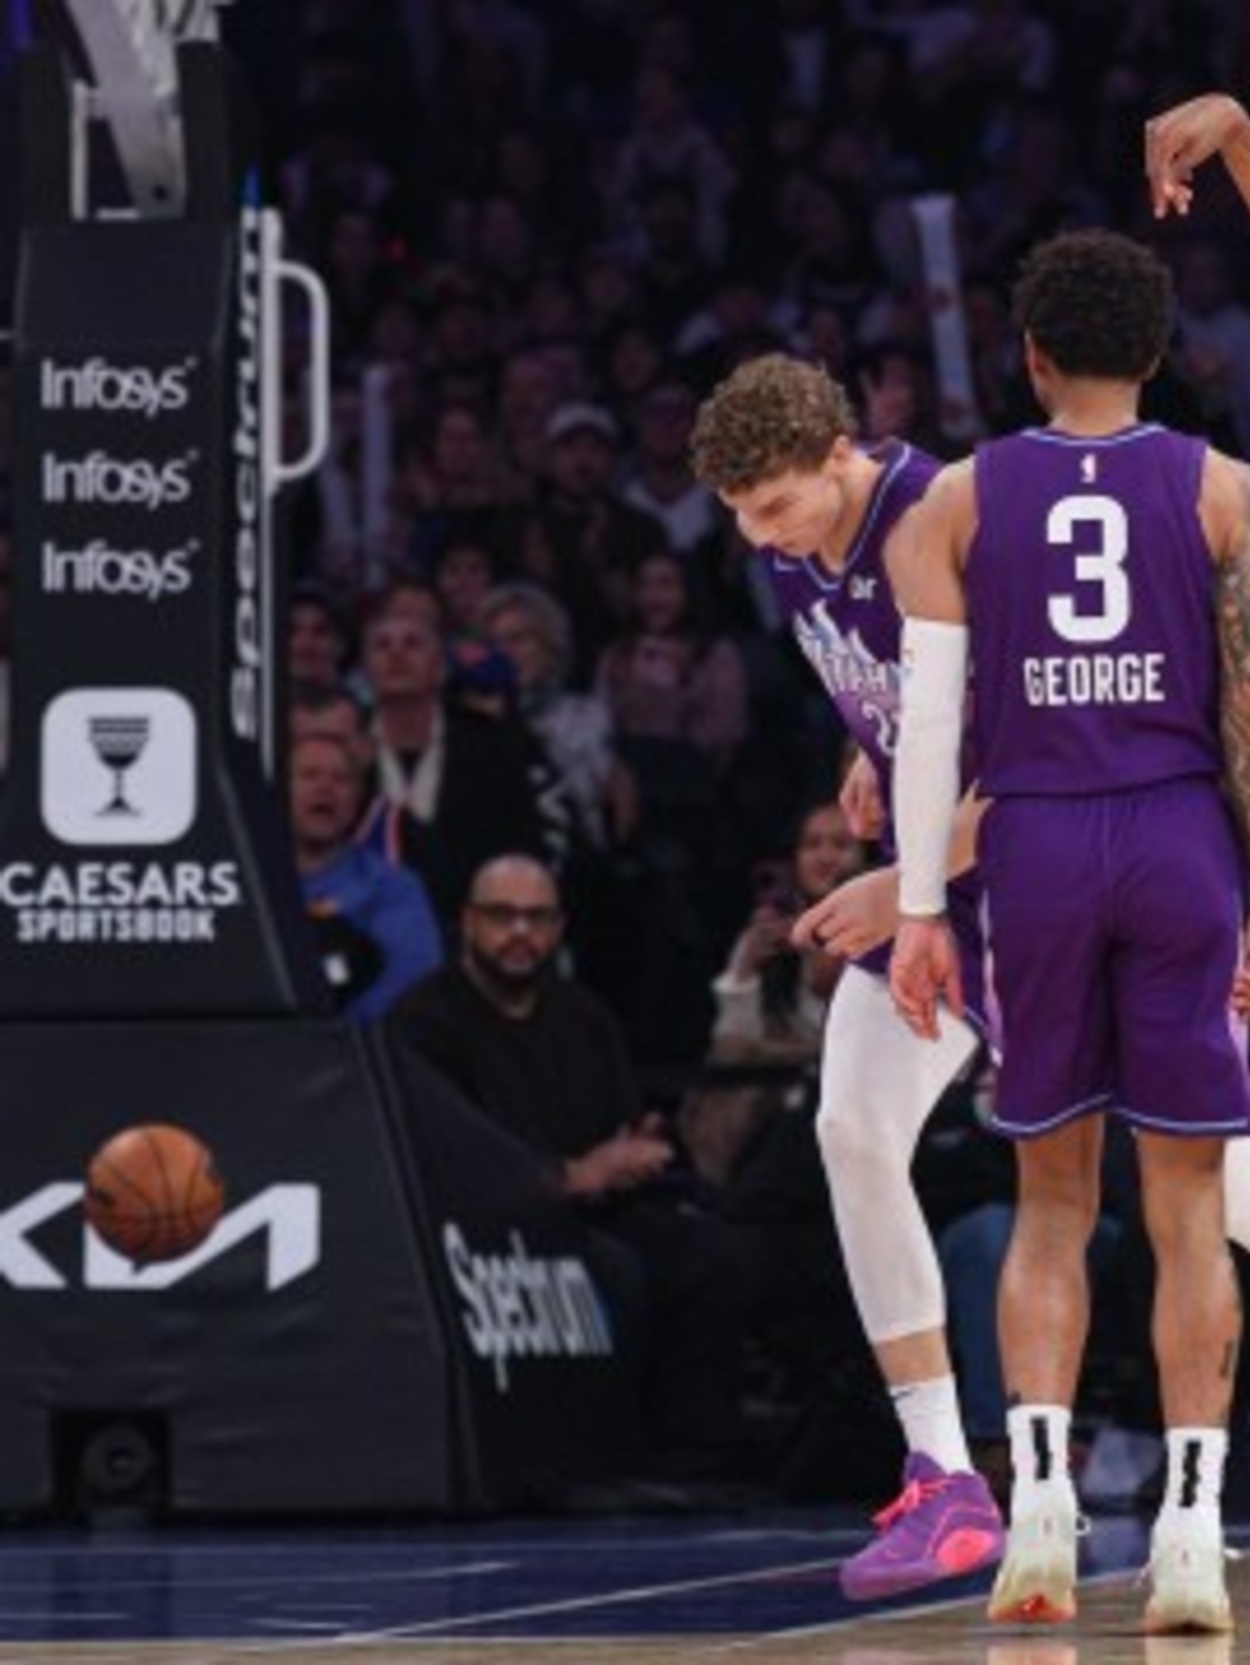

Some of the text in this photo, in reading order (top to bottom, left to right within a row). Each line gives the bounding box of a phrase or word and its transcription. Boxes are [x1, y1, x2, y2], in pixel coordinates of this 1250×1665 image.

[41, 356, 189, 418] Infosys
[43, 450, 191, 511] Infosys
[43, 540, 191, 600] Infosys
[1046, 495, 1130, 643] 3
[1024, 653, 1165, 706] GEORGE
[861, 698, 899, 758] 2
[0, 861, 240, 907] CAESARS
[17, 907, 215, 943] SPORTSBOOK
[442, 1222, 612, 1392] Spectrum
